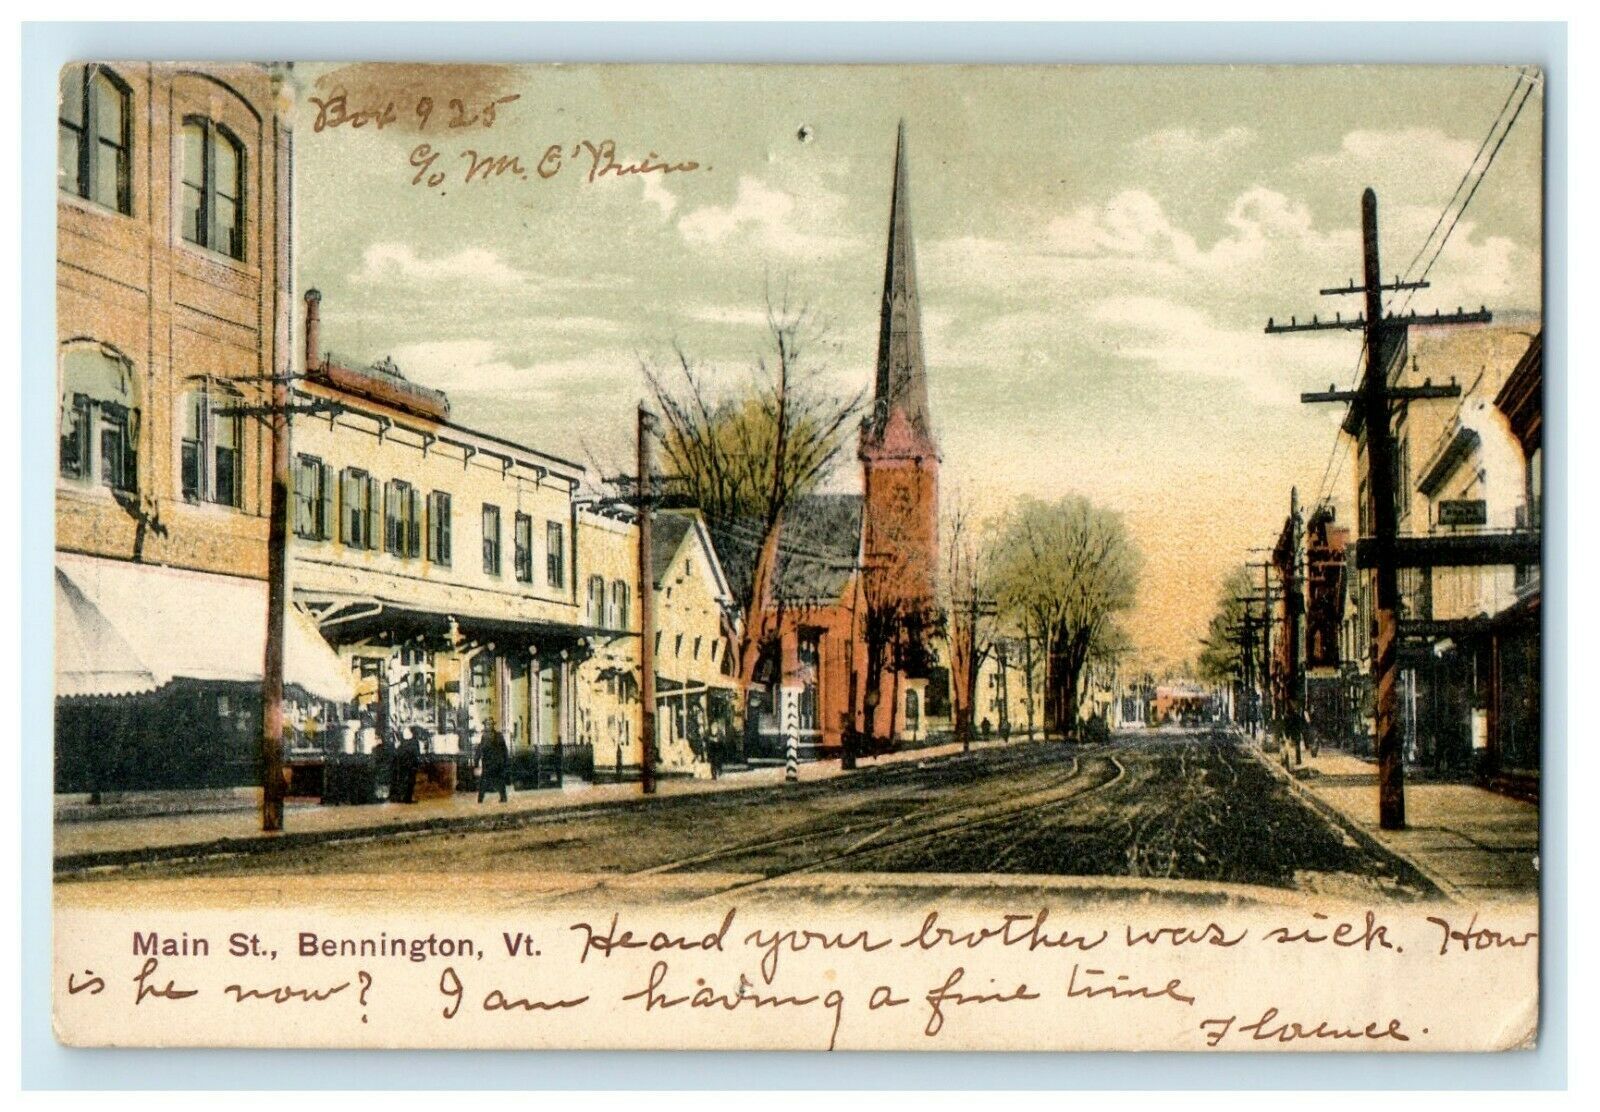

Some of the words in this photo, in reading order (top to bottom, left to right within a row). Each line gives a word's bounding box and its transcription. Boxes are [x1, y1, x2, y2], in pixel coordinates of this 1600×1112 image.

[132, 932, 210, 956] Main
[228, 932, 278, 959] St.,
[299, 931, 484, 962] Bennington,
[503, 932, 542, 956] Vt.
[570, 907, 736, 964] Heard
[744, 922, 893, 984] your
[901, 908, 1108, 953] brother
[1127, 922, 1247, 948] was
[1426, 912, 1538, 956] How
[67, 970, 106, 995] is
[133, 957, 198, 1005] he
[224, 970, 373, 1024] now?
[439, 967, 464, 1019] I
[483, 990, 590, 1010] am
[622, 960, 844, 1051] having
[868, 985, 909, 1009] a
[924, 966, 1041, 1037] fine
